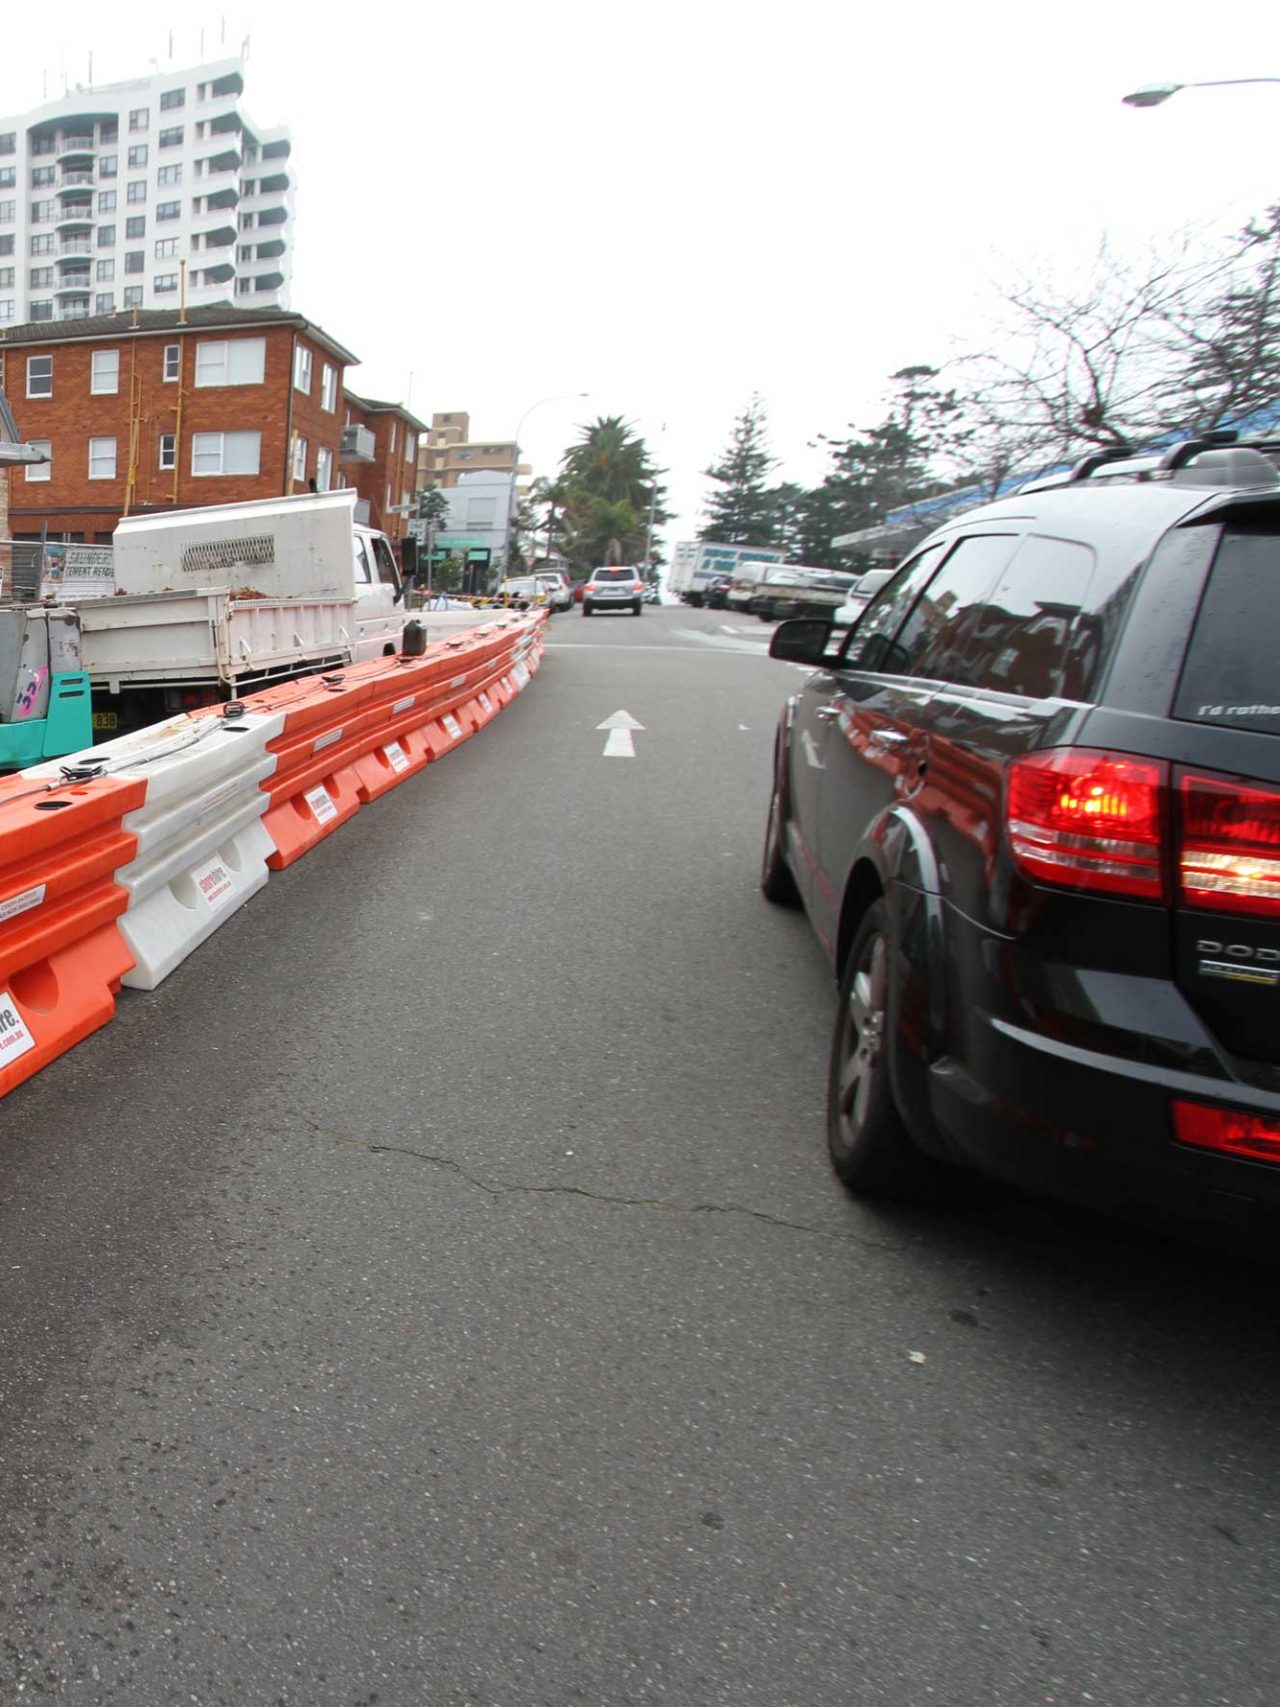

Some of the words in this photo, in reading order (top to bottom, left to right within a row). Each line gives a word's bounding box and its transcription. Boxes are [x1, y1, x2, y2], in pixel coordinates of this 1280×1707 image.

[1226, 704, 1280, 716] rathe
[95, 713, 116, 727] 838
[1197, 940, 1280, 961] DOD
